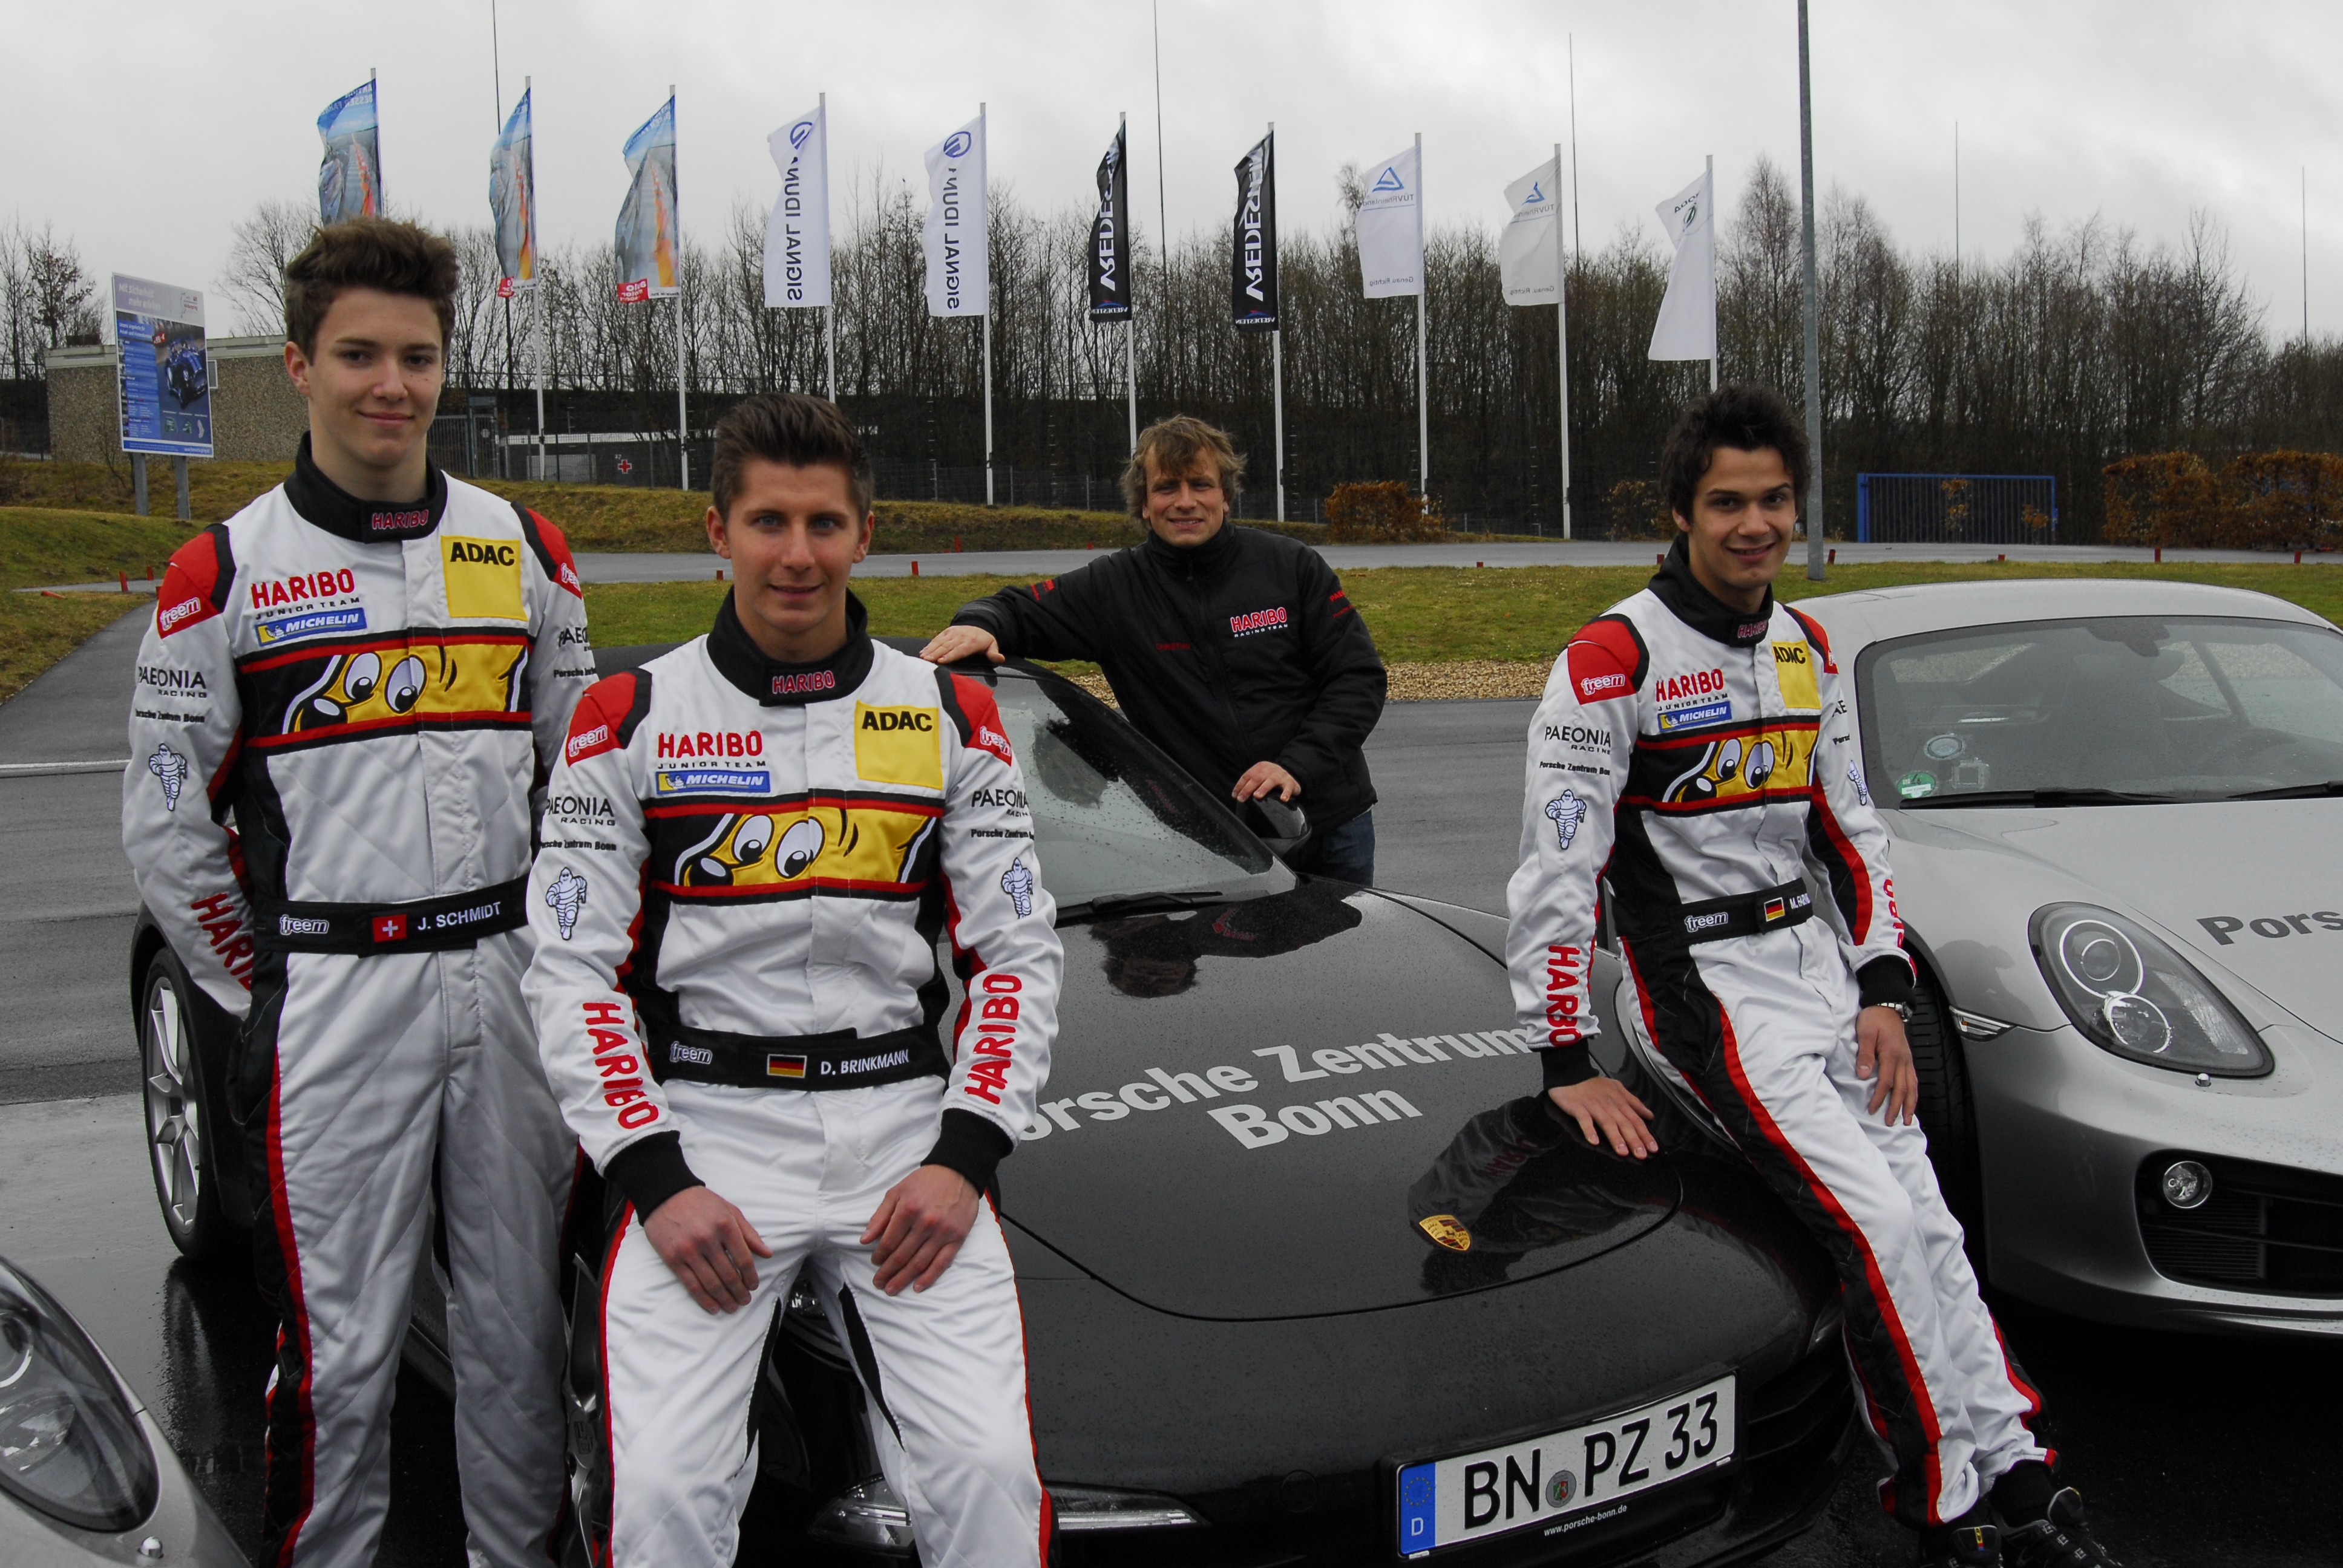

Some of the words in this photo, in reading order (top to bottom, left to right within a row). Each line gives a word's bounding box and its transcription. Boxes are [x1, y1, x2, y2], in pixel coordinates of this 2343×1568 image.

[372, 509, 428, 530] HARIBO
[450, 542, 514, 566] ADAC
[251, 569, 356, 609] HARIBO
[160, 597, 201, 630] freem
[255, 604, 314, 620] JUNIOR
[320, 596, 361, 608] TEAM
[1230, 607, 1287, 632] HARIBO
[286, 613, 358, 633] MICHELIN
[1234, 628, 1265, 638] RACING
[1772, 646, 1806, 664] ADAC
[158, 689, 207, 698] RACING
[772, 670, 835, 694] HARIBO
[1581, 673, 1625, 696] freem
[1656, 668, 1724, 702] HARIBO
[1658, 700, 1697, 711] JUNIOR
[1701, 693, 1728, 704] TEAM
[1679, 706, 1727, 722] MICHELIN
[862, 711, 932, 732] ADAC
[568, 725, 608, 757] freem
[657, 730, 762, 759] HARIBO
[1544, 725, 1611, 748] PAEONIA
[658, 761, 718, 769] JUNIOR
[725, 760, 766, 768] TEAM
[686, 774, 764, 786] MICHELIN
[561, 817, 615, 826] RACING
[280, 914, 330, 935] freem
[417, 916, 431, 931] J.
[436, 901, 501, 927] SCHMIDT
[1685, 912, 1728, 933] freem
[2196, 911, 2343, 946] Pors
[191, 893, 254, 991] HARI
[1546, 945, 1582, 1047] HARBO
[964, 973, 1022, 1105] HARIBO
[669, 1041, 713, 1065] freem
[820, 1060, 837, 1077] D.
[841, 1049, 909, 1074] BRINKMANN
[582, 1002, 660, 1130] HARIBO
[1018, 1063, 1259, 1142] orsche
[1252, 1028, 1533, 1083] Zentrum
[1207, 1089, 1424, 1150] Bonn
[1464, 1448, 1541, 1529] BN
[1584, 1417, 1650, 1497] PZ
[1665, 1391, 1717, 1470] 33
[1411, 1517, 1424, 1536] D
[1544, 1504, 1628, 1537] www.porsche-bonn.de
